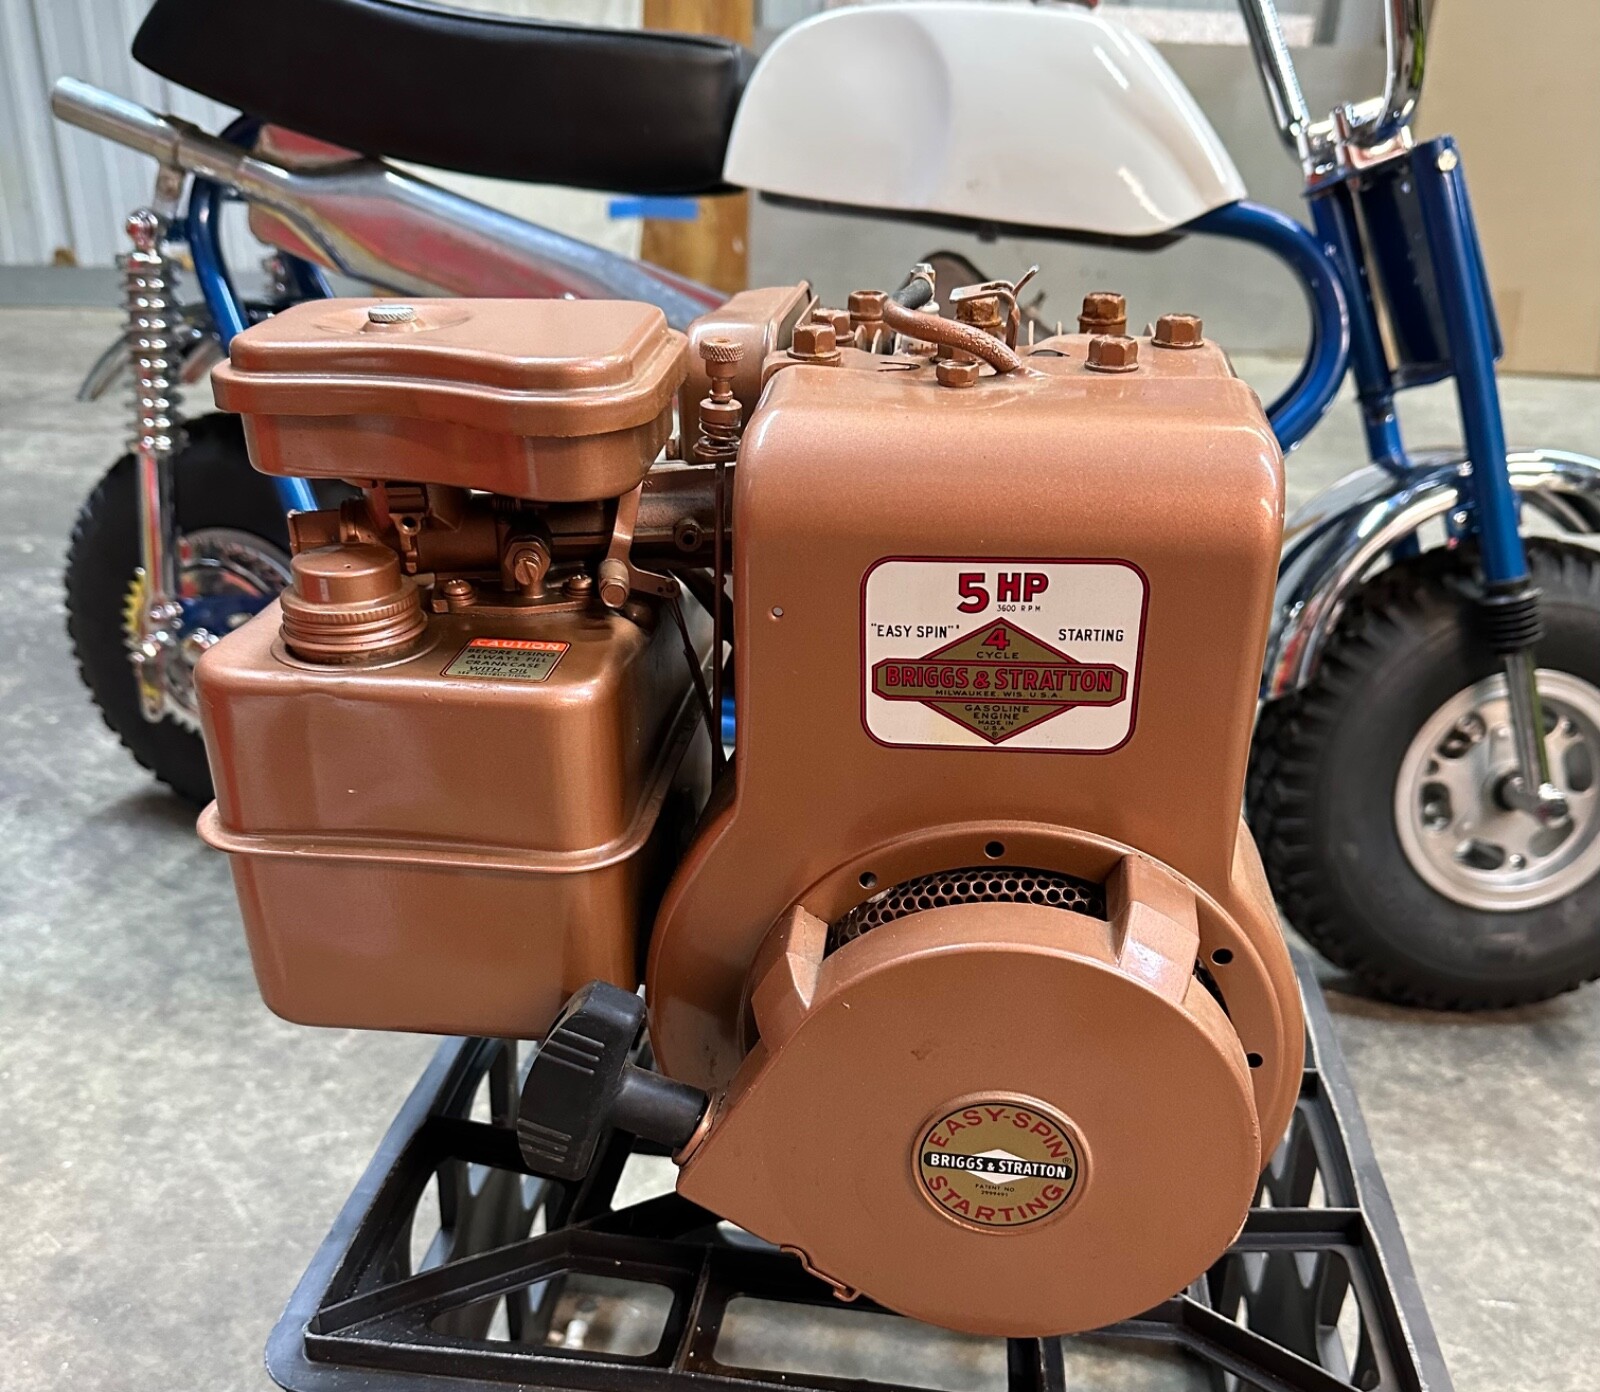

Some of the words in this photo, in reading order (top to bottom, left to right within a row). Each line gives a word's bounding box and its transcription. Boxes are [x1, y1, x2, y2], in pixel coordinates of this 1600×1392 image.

[957, 573, 990, 614] 5
[997, 573, 1049, 602] HP
[997, 604, 1016, 612] 3600
[981, 628, 1010, 651] 4
[1058, 629, 1124, 642] STARTING
[476, 640, 560, 650] CAUTION
[467, 648, 513, 656] BEFORE
[976, 651, 1019, 660] CYCLE
[467, 654, 519, 662] ALWAYS
[465, 660, 541, 669] CRANKCASE
[885, 666, 969, 689] BRIGGS
[973, 670, 991, 690] &
[995, 668, 1114, 692] STRATTON
[964, 704, 1030, 713] GASOLINE
[973, 712, 1020, 721] ENGINE
[930, 1153, 984, 1171] BRIGGS
[986, 1161, 996, 1172] &
[998, 1160, 1067, 1179] STRATTON
[975, 1183, 1001, 1191] PATENT
[928, 1175, 1065, 1222] STARTING
